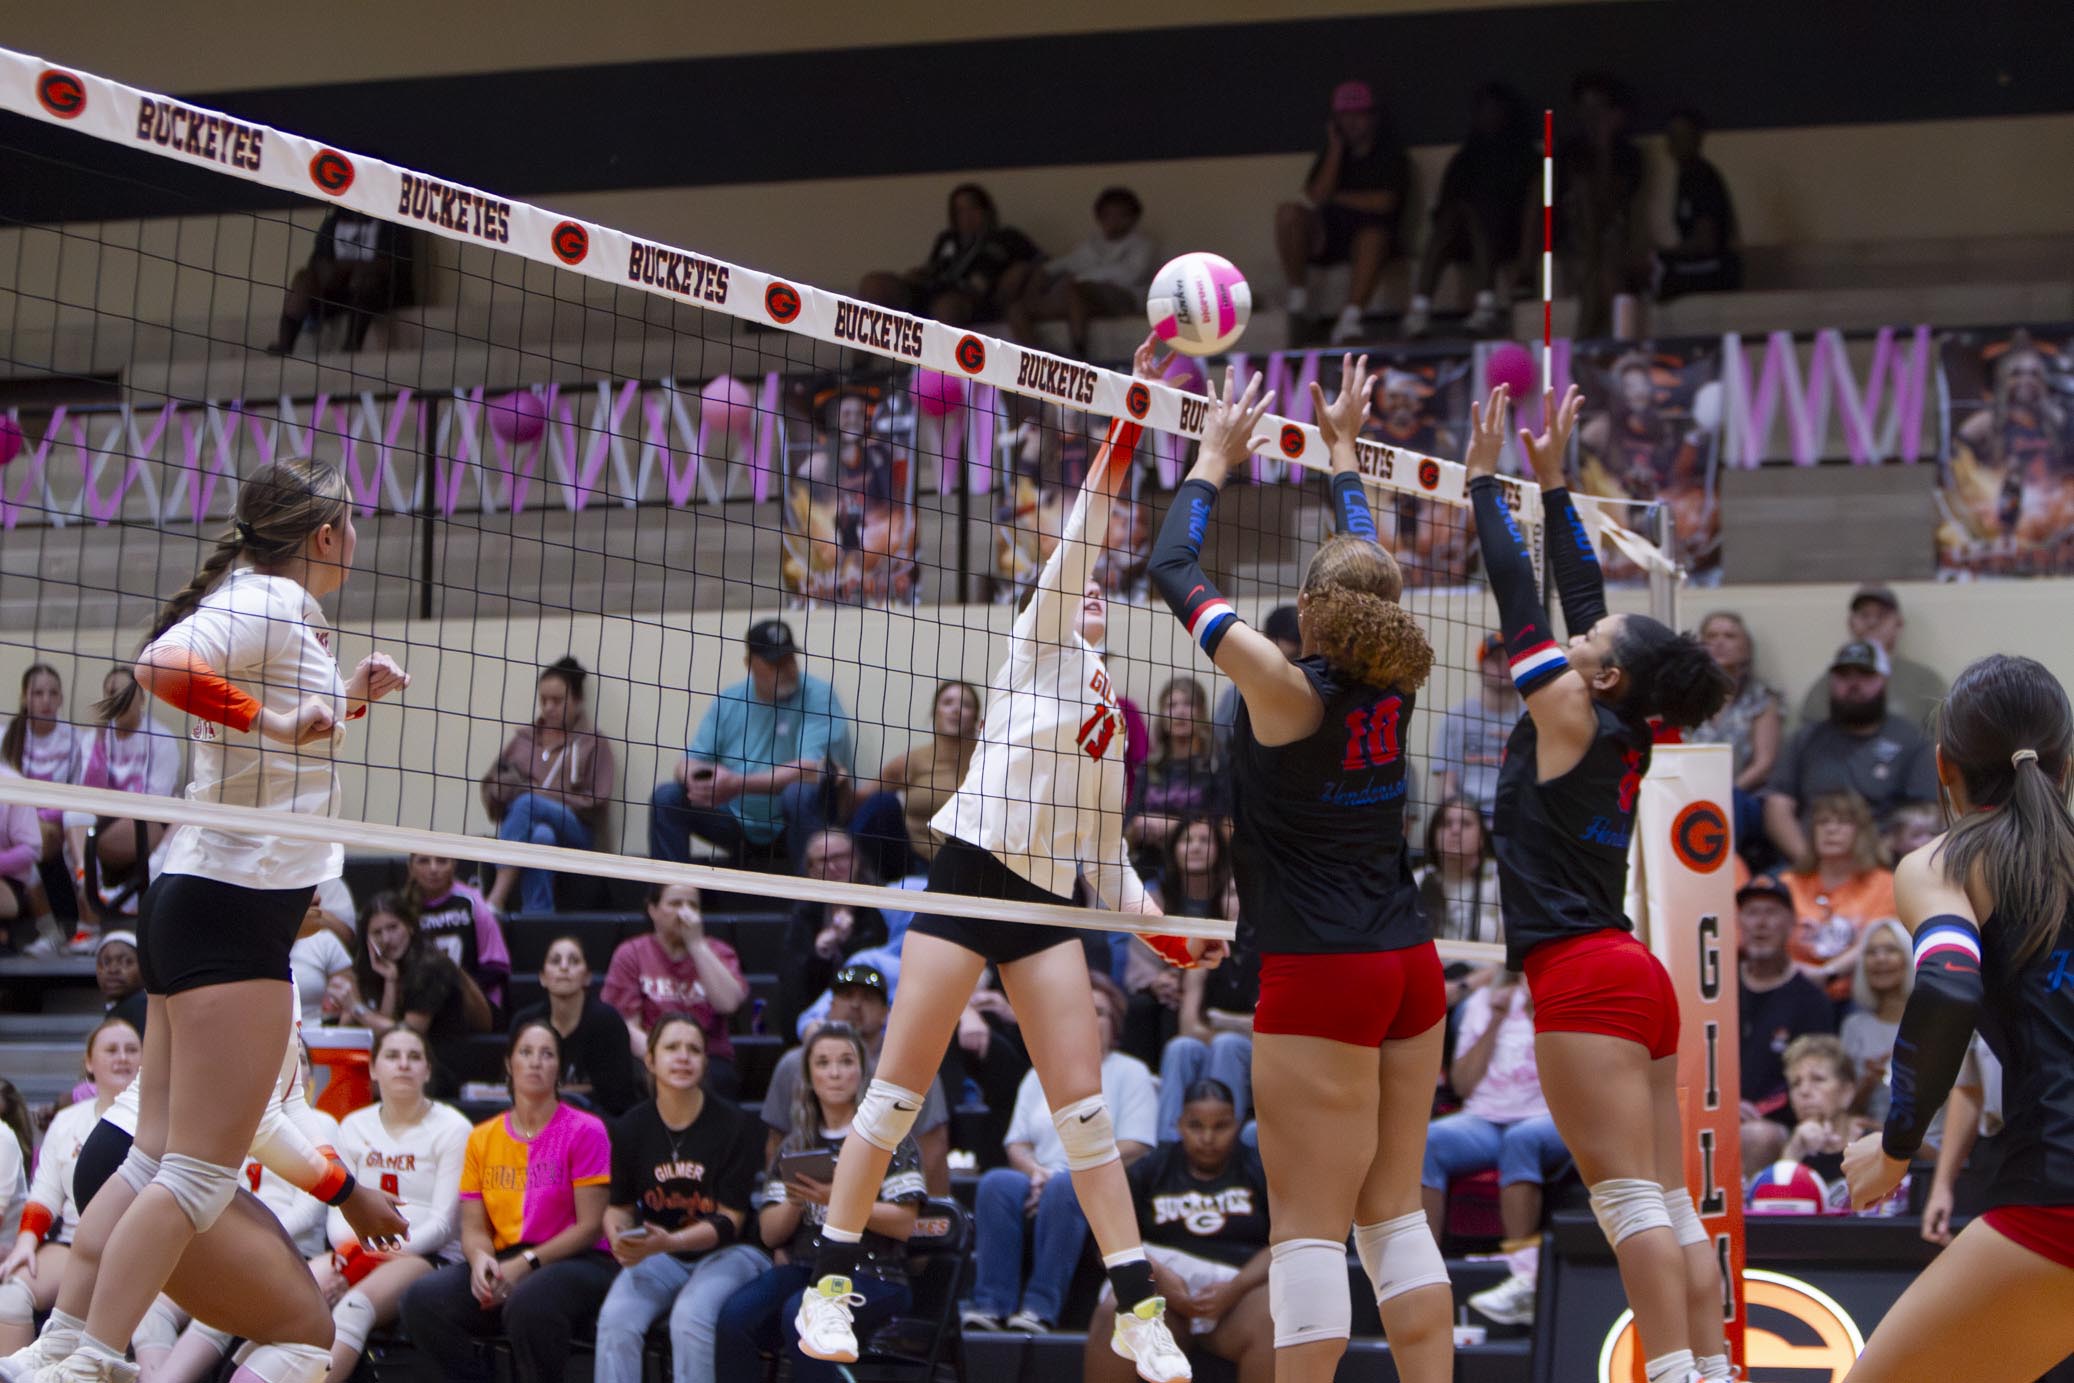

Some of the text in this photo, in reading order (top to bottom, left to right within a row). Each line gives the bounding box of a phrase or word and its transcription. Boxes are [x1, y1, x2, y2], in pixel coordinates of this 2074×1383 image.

[40, 74, 84, 114] G
[137, 97, 263, 171] BUCKEYES
[312, 152, 351, 191] G
[398, 173, 510, 243] BUCKEYES
[553, 224, 587, 260] G
[629, 242, 729, 304] BUCKEYES
[767, 285, 798, 320] G
[835, 301, 923, 358] BUCKEYES
[958, 338, 984, 371] G
[1017, 351, 1098, 404] BUCKEYES
[1128, 385, 1149, 417] G
[1281, 427, 1304, 455] G
[1343, 696, 1402, 770] 10
[1677, 808, 1728, 866] G
[654, 1161, 706, 1183] GILMER
